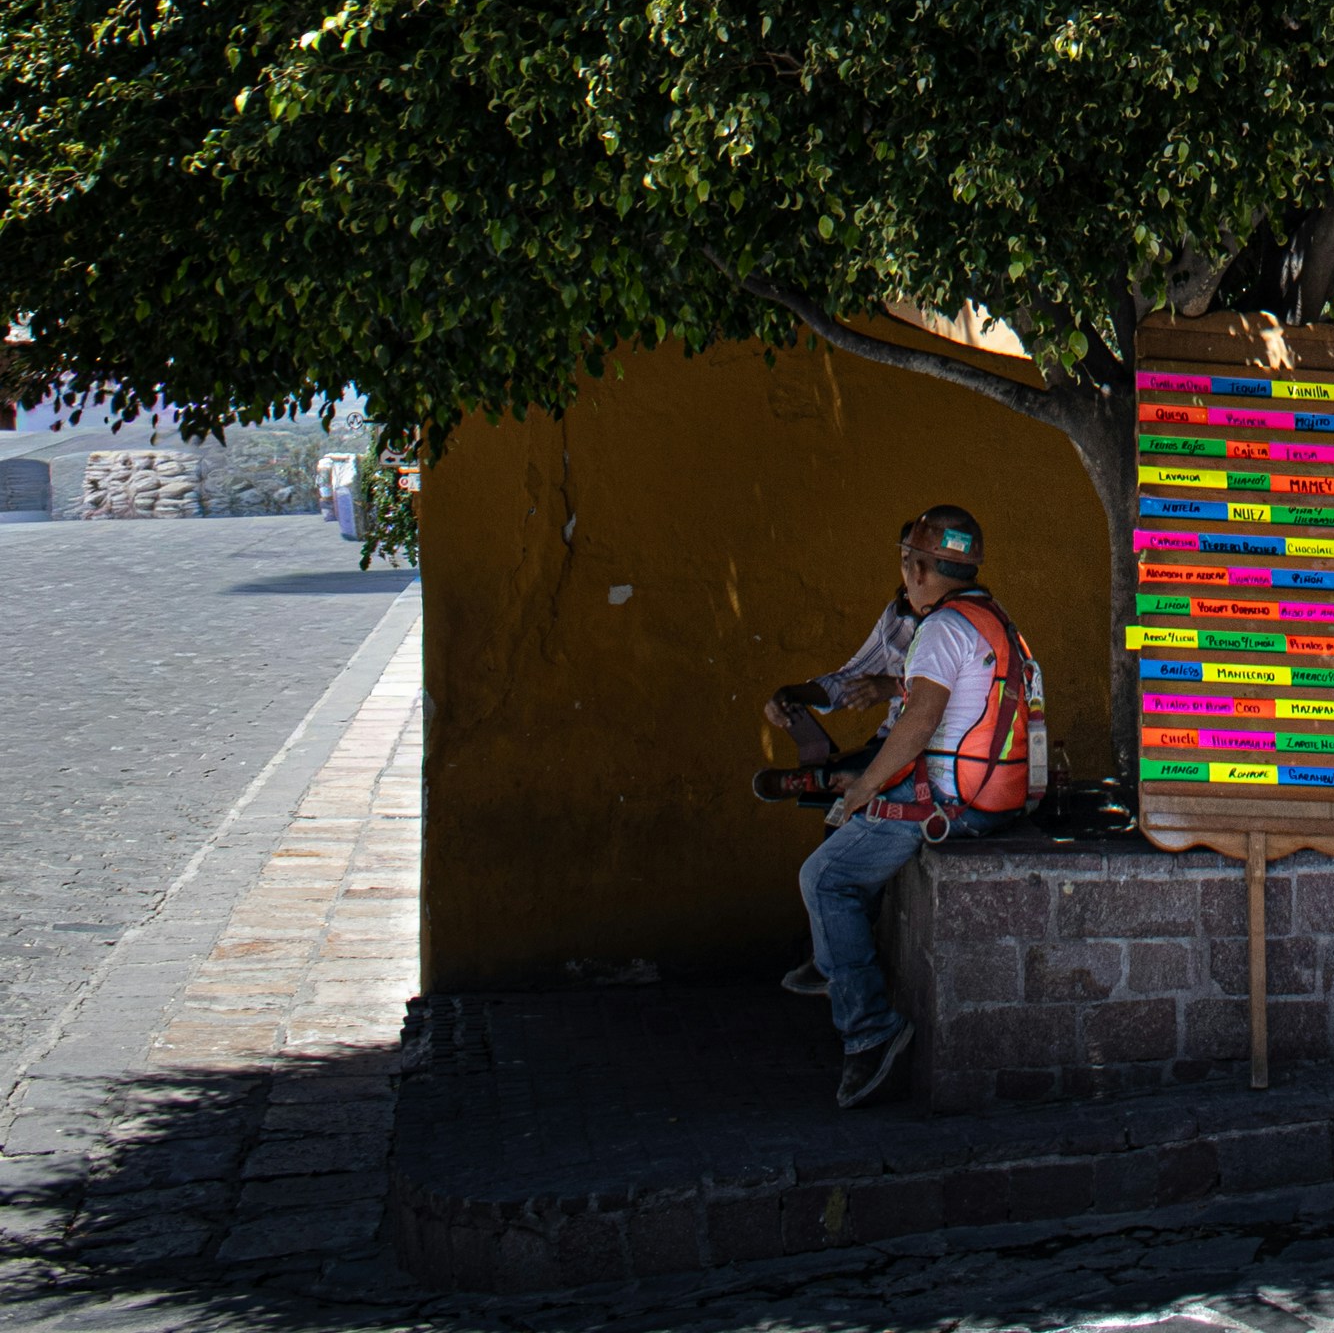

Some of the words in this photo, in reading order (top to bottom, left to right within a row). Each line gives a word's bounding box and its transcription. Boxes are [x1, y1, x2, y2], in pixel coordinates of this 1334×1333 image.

[1289, 478, 1332, 493] MAMEY
[1233, 507, 1267, 522] NUEZ
[1217, 668, 1276, 682] MANTECADO
[1161, 765, 1199, 775] MANGO
